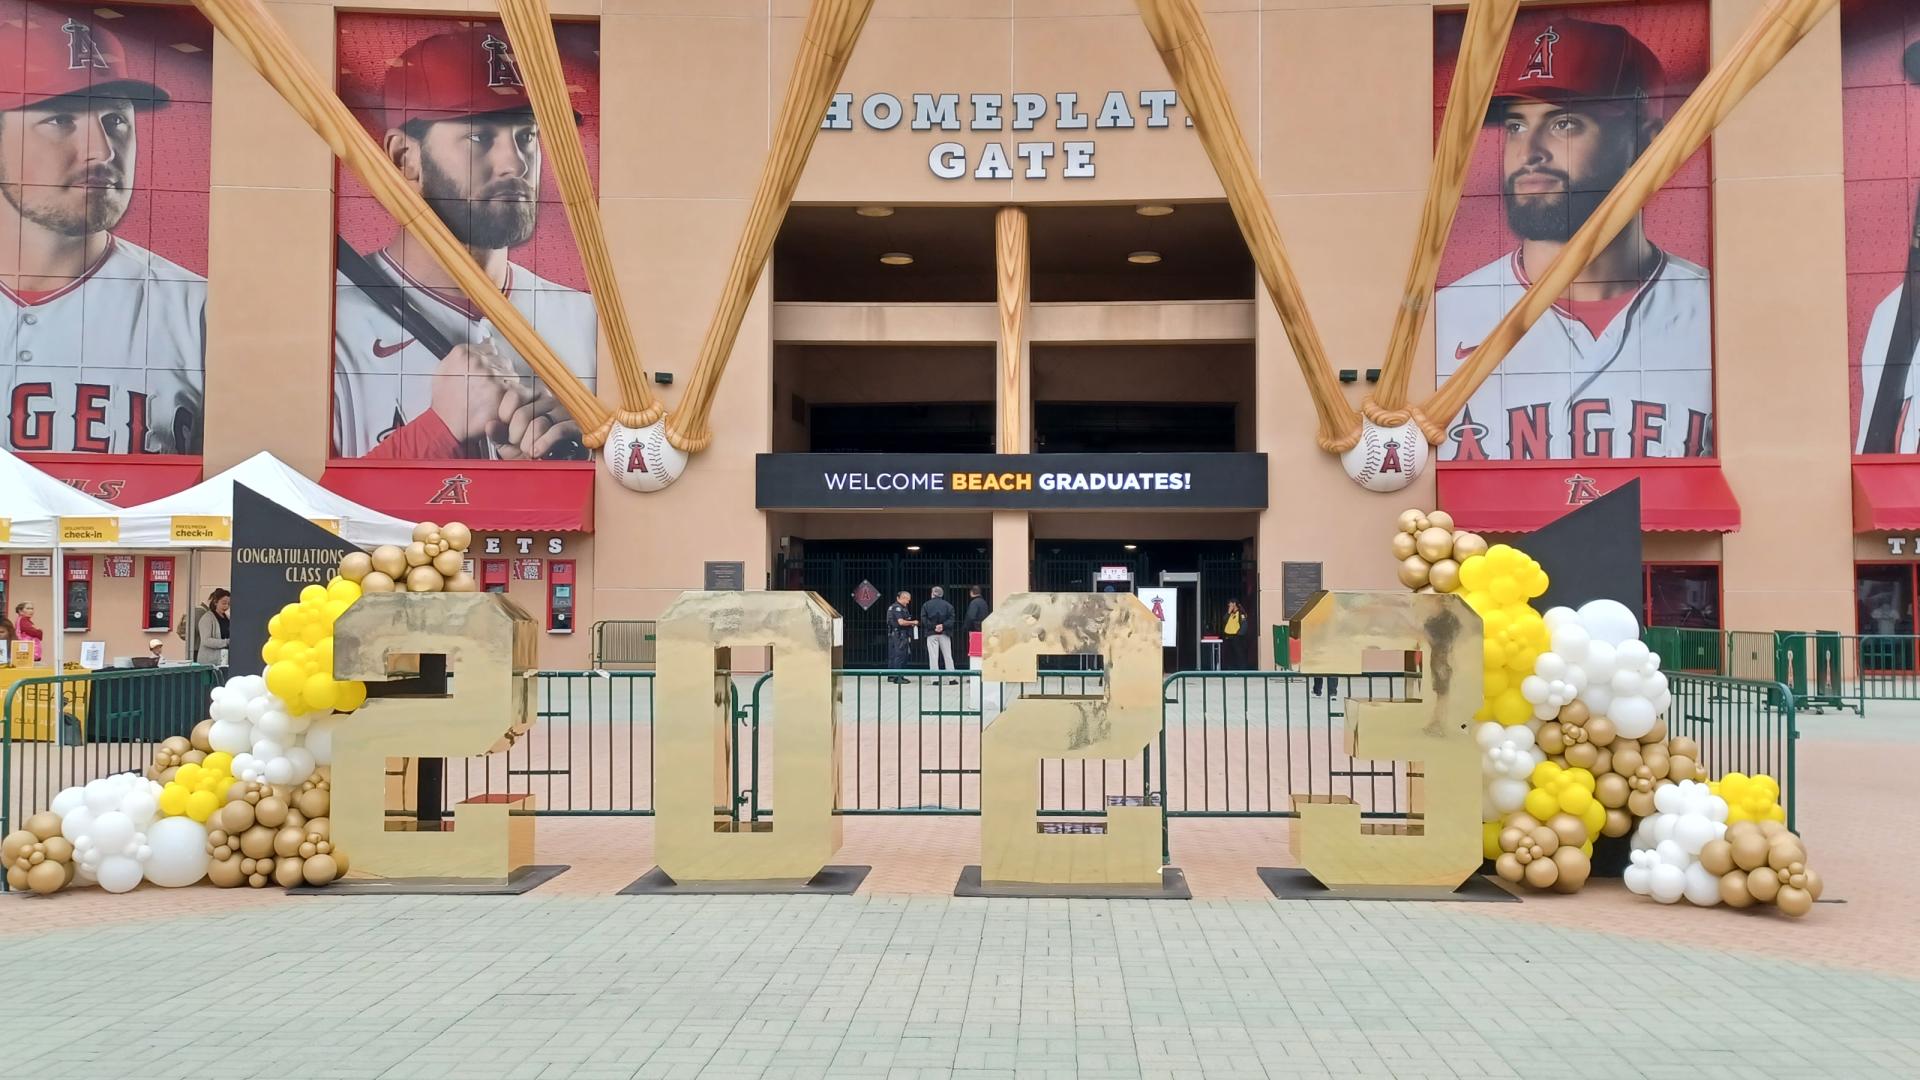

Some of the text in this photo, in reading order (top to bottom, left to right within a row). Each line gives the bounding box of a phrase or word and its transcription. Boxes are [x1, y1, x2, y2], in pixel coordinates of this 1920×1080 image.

[821, 90, 1194, 131] HOMEPLAT
[928, 141, 1096, 180] GATE
[824, 472, 1192, 491] WELCOME BEACH GRADUATES!
[64, 530, 103, 539] check-in
[175, 529, 214, 538] check-in
[463, 537, 564, 555] ETS
[237, 547, 344, 565] CONGRATULATIONS
[285, 567, 341, 582] CLASS O
